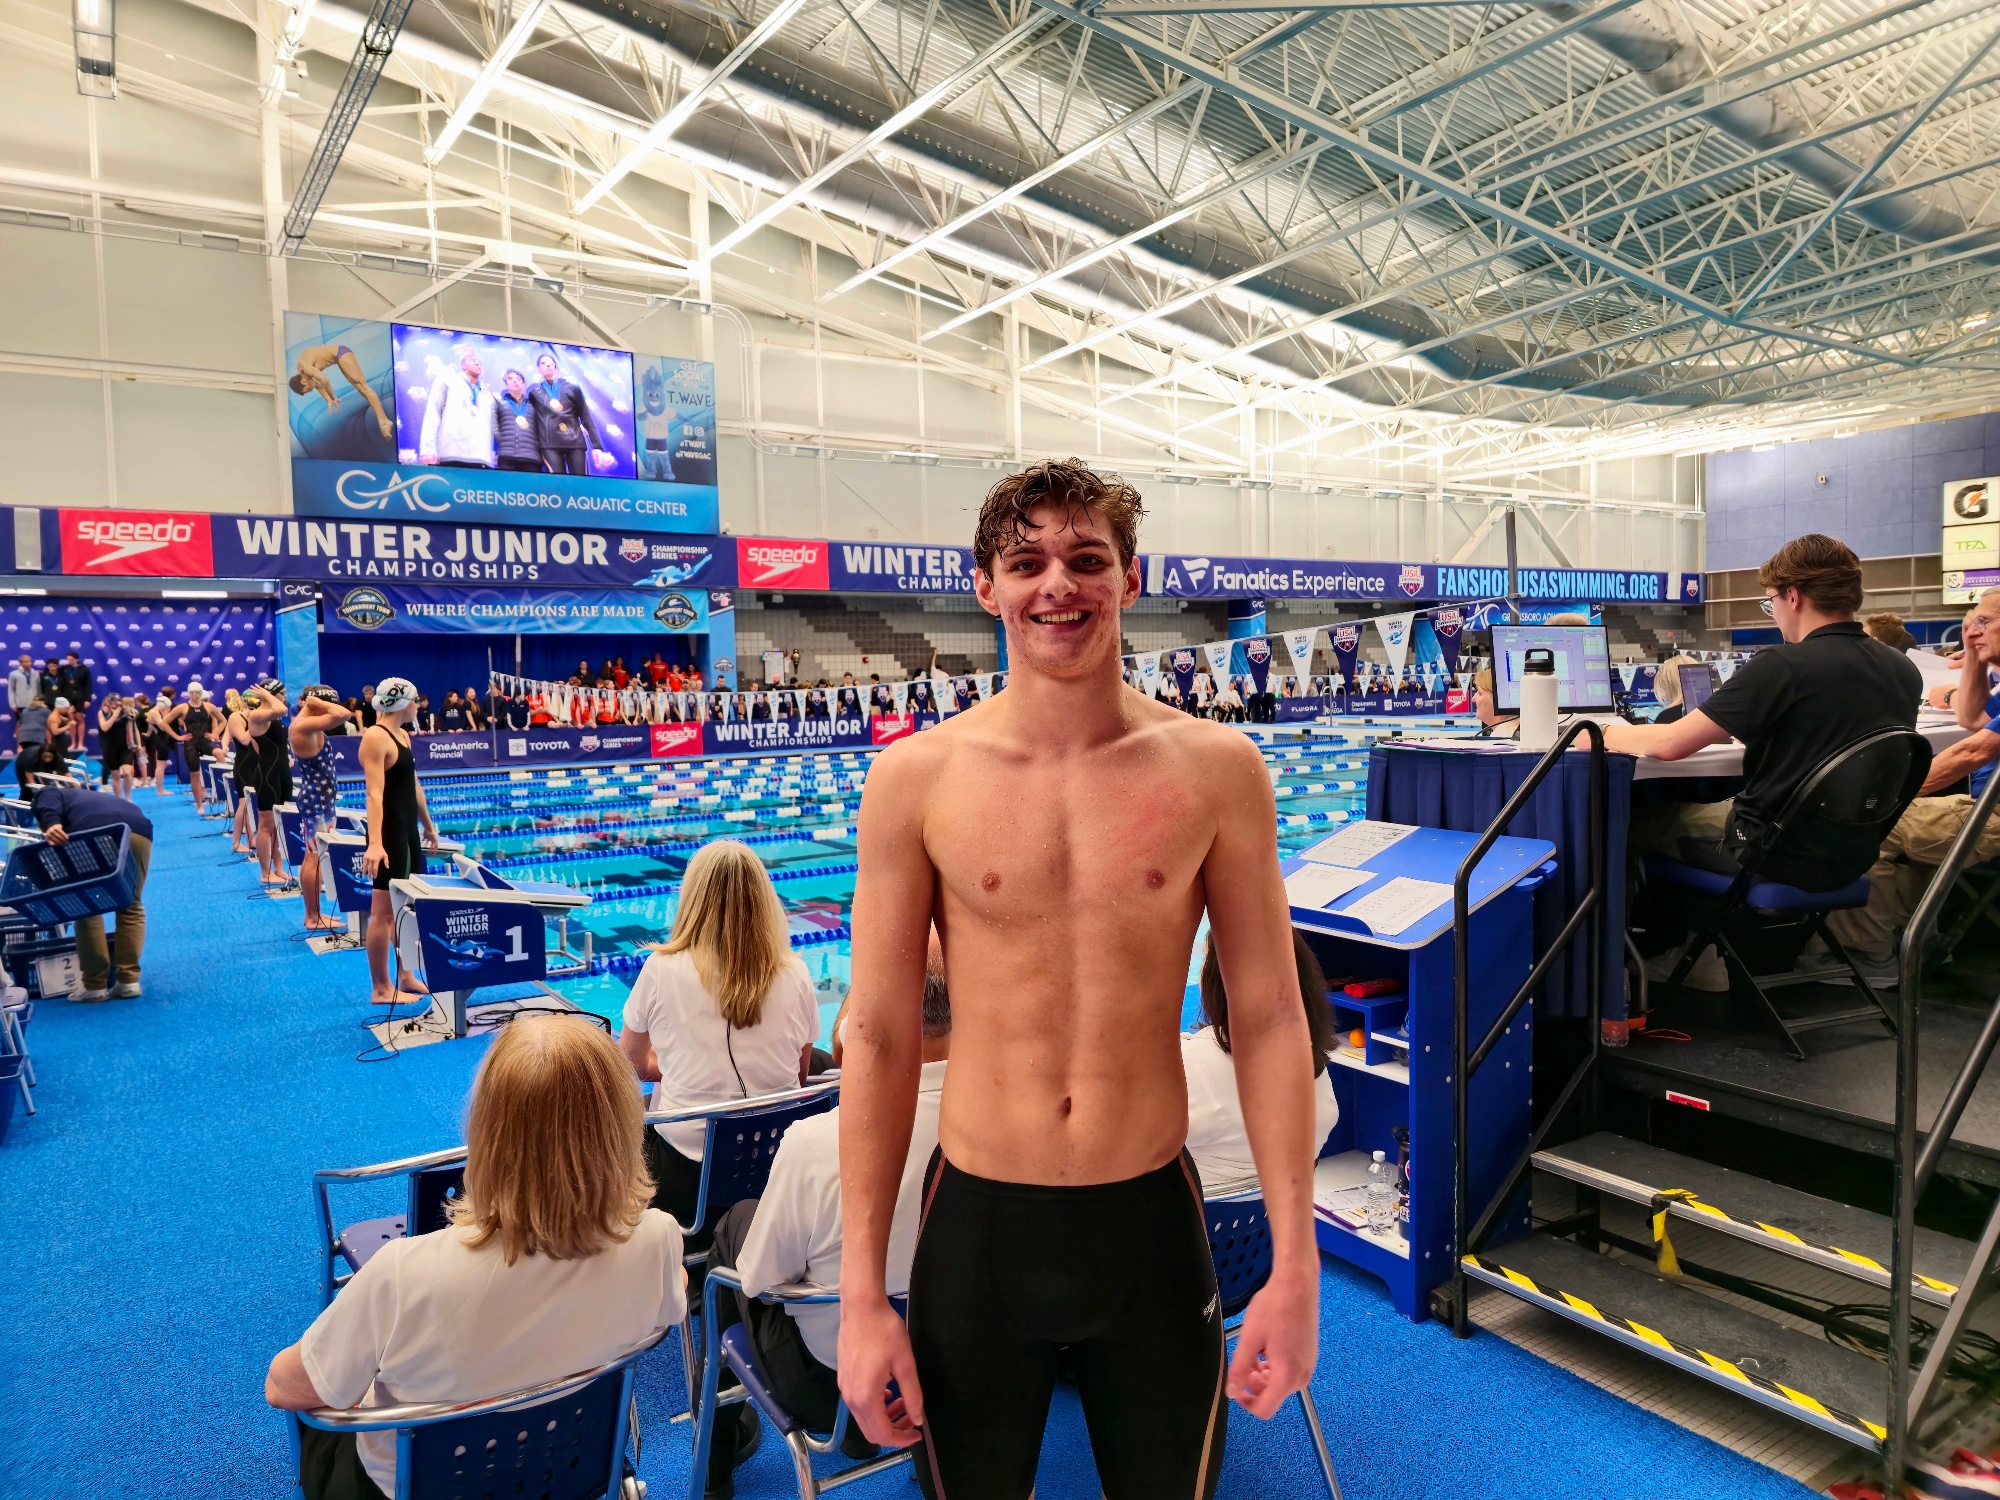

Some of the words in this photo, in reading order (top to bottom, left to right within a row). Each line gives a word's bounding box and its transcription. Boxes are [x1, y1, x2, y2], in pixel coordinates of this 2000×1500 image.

[680, 361, 699, 371] GET
[673, 370, 706, 382] SOCIAL
[667, 390, 712, 408] T.WAVE
[336, 469, 451, 513] GAC
[453, 488, 562, 508] GREENSBORO
[566, 495, 631, 512] AQUATIC
[635, 500, 688, 516] CENTER
[77, 518, 193, 545] speedo
[236, 518, 433, 560] WINTER
[443, 528, 609, 566] JUNIOR
[651, 545, 708, 555] CHAMPIONSHIP
[651, 551, 678, 560] SERIES
[748, 544, 817, 566] speedo
[842, 545, 963, 577] WINTER
[328, 558, 539, 580] CHAMPIONSHIPS
[1404, 569, 1419, 577] USA
[898, 576, 976, 591] CHAMPIO
[1213, 565, 1289, 590] Fanatics
[1292, 569, 1385, 595] Experience
[284, 584, 312, 595] GAC
[406, 603, 467, 617] WHERE
[470, 604, 567, 617] CHAMPIONS
[570, 605, 600, 618] ARE
[602, 605, 645, 618] MADE
[1441, 612, 1457, 621] USA
[1339, 628, 1353, 637] USA
[655, 728, 697, 740] speedo
[715, 721, 790, 742] WINTER
[794, 719, 862, 737] JUNIOR
[429, 740, 489, 752] OneAmerica
[529, 740, 571, 751] TOYOTA
[748, 735, 833, 748] CHAMPIONSHIPS
[429, 750, 463, 759] Financial
[445, 914, 489, 926] WINTER
[445, 923, 489, 935] JUNIOR
[505, 925, 529, 962] 1
[63, 958, 72, 970] 2
